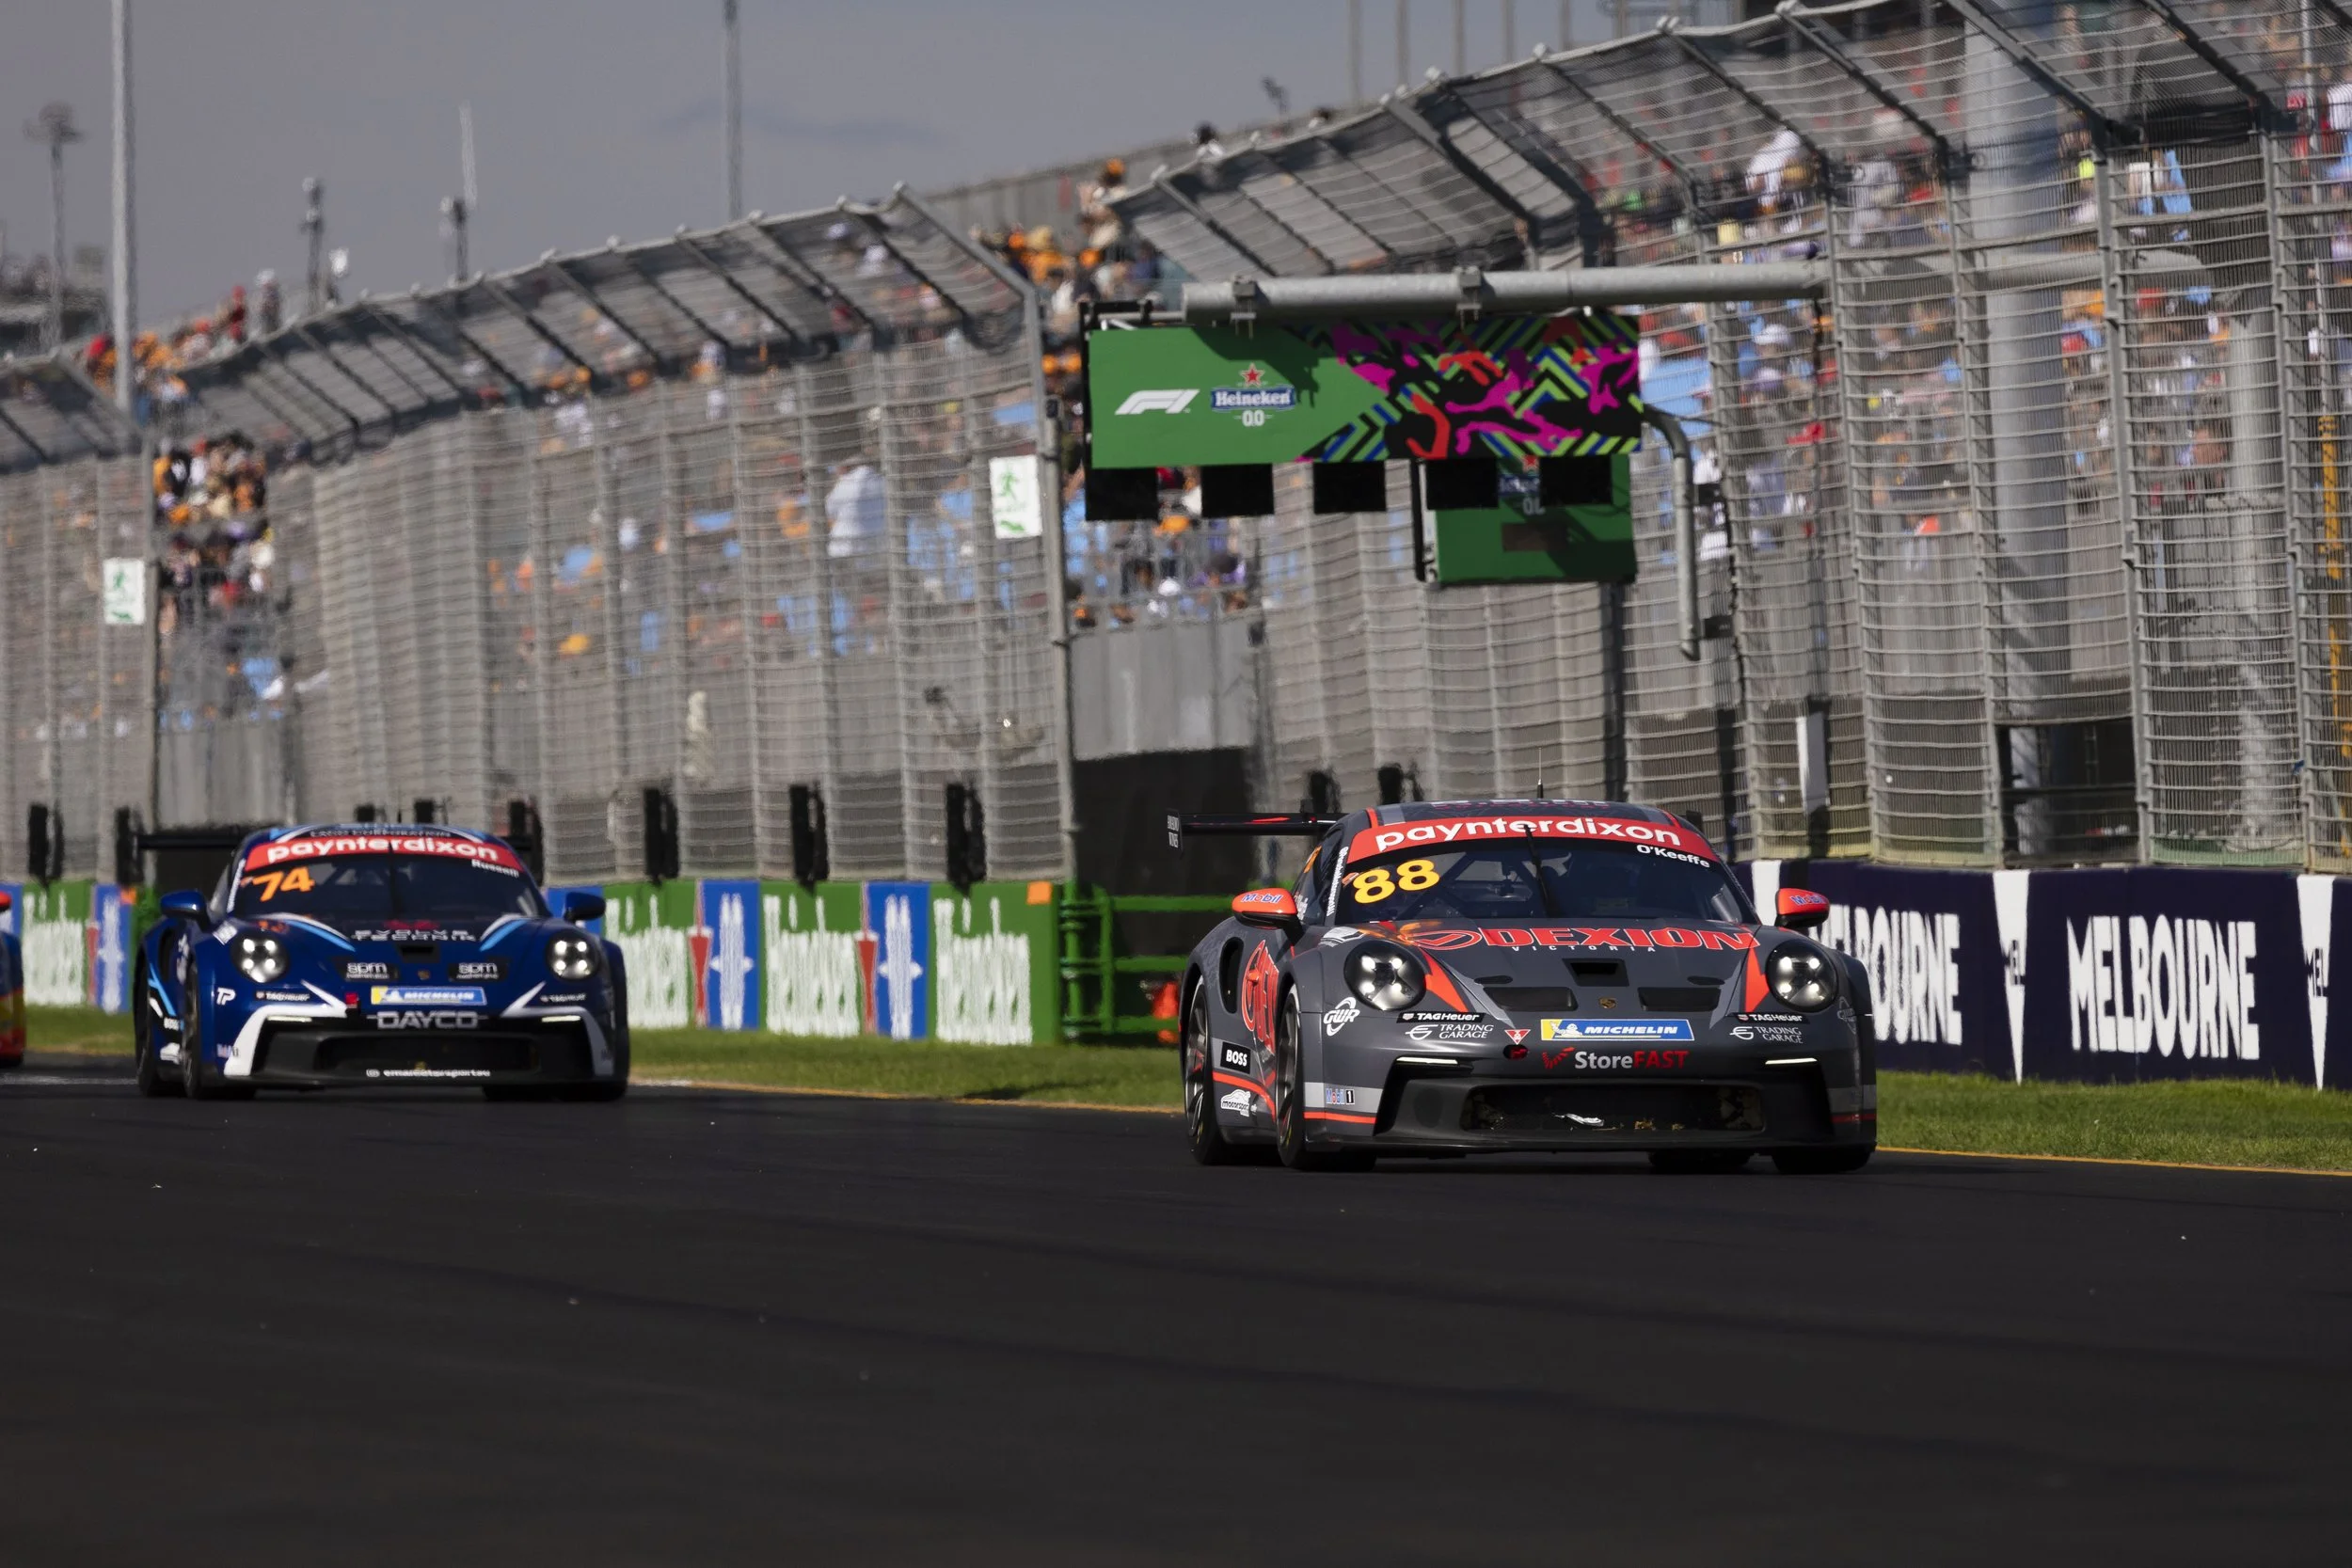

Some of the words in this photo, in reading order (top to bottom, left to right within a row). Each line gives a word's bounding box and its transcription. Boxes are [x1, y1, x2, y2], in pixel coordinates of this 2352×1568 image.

[1115, 388, 1200, 415] F1
[1215, 388, 1292, 407] Heineken
[1375, 817, 1681, 852] paynterdixon
[267, 835, 499, 863] paynterdixon
[1636, 844, 1710, 868] O'Keeffe
[252, 865, 315, 902] 74
[1352, 859, 1440, 904] 88
[1241, 893, 1283, 904] Mobil
[1477, 927, 1761, 951] DEXION
[1511, 944, 1657, 953] VICTORIA
[2067, 913, 2260, 1060] MELBOURNE
[377, 1010, 479, 1029] DAYCO
[1438, 1023, 1494, 1032] TRADING
[1438, 1031, 1488, 1039] GARAGE
[1584, 1025, 1678, 1035] MICHELIN
[1755, 1026, 1802, 1035] TRADING
[1763, 1034, 1804, 1044] GARAGE
[1226, 1049, 1248, 1067] BOSS
[1574, 1050, 1691, 1069] StoreFAST
